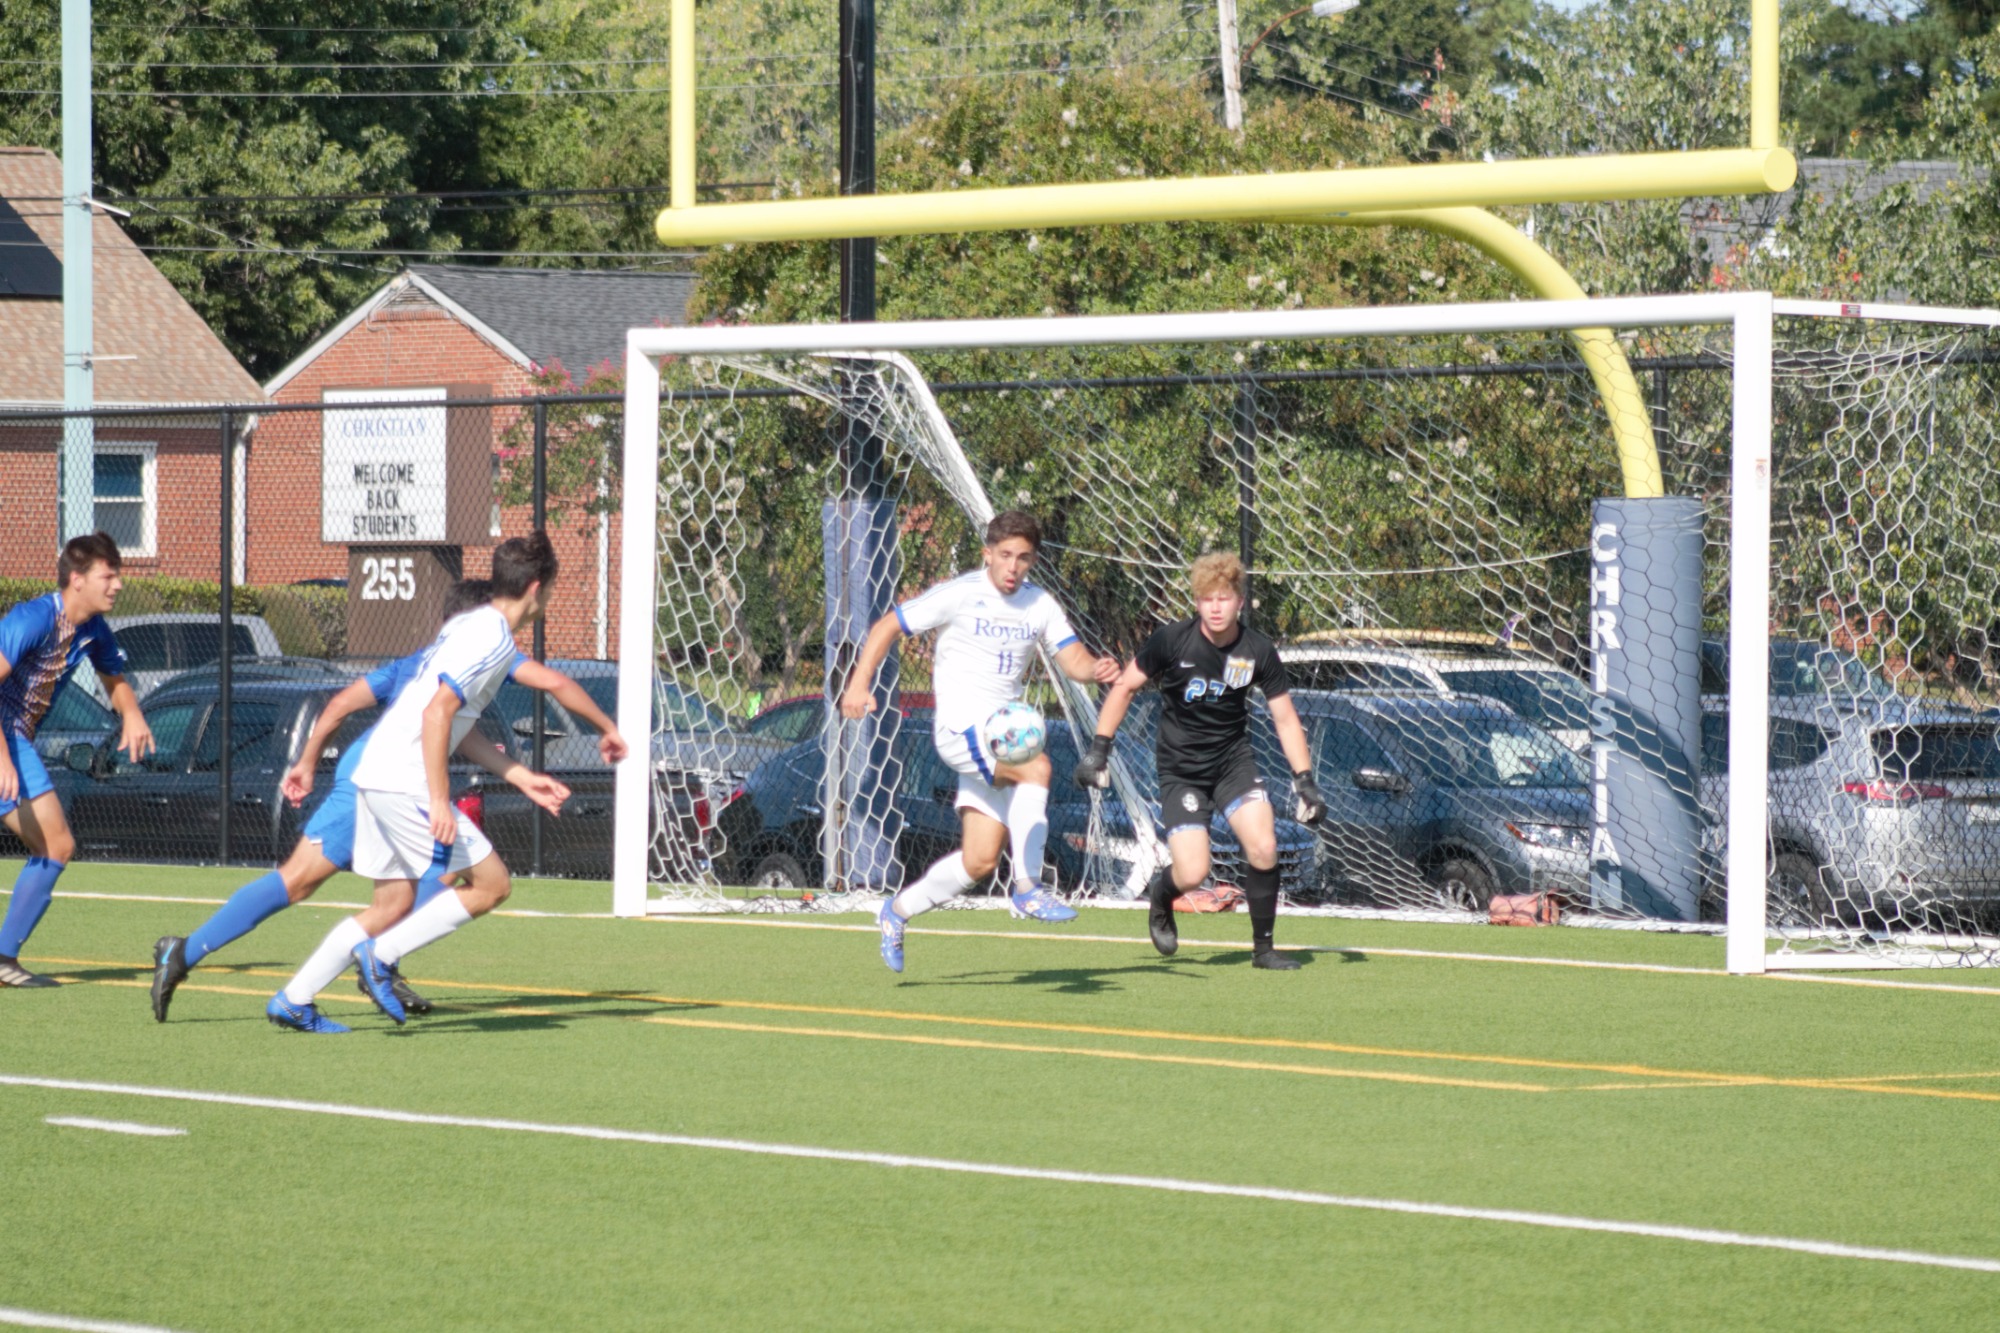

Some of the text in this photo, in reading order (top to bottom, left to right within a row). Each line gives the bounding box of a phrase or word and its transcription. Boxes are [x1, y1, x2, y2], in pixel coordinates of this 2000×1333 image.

[342, 417, 427, 438] CHRISTIAN
[353, 463, 415, 485] WELCOME
[366, 488, 401, 511] BACK
[352, 514, 418, 536] STUDENTS
[361, 556, 416, 601] 255
[974, 617, 1040, 646] Royals
[997, 651, 1014, 675] 11
[1185, 677, 1227, 703] 27
[1590, 522, 1624, 910] CHRISTIAN
